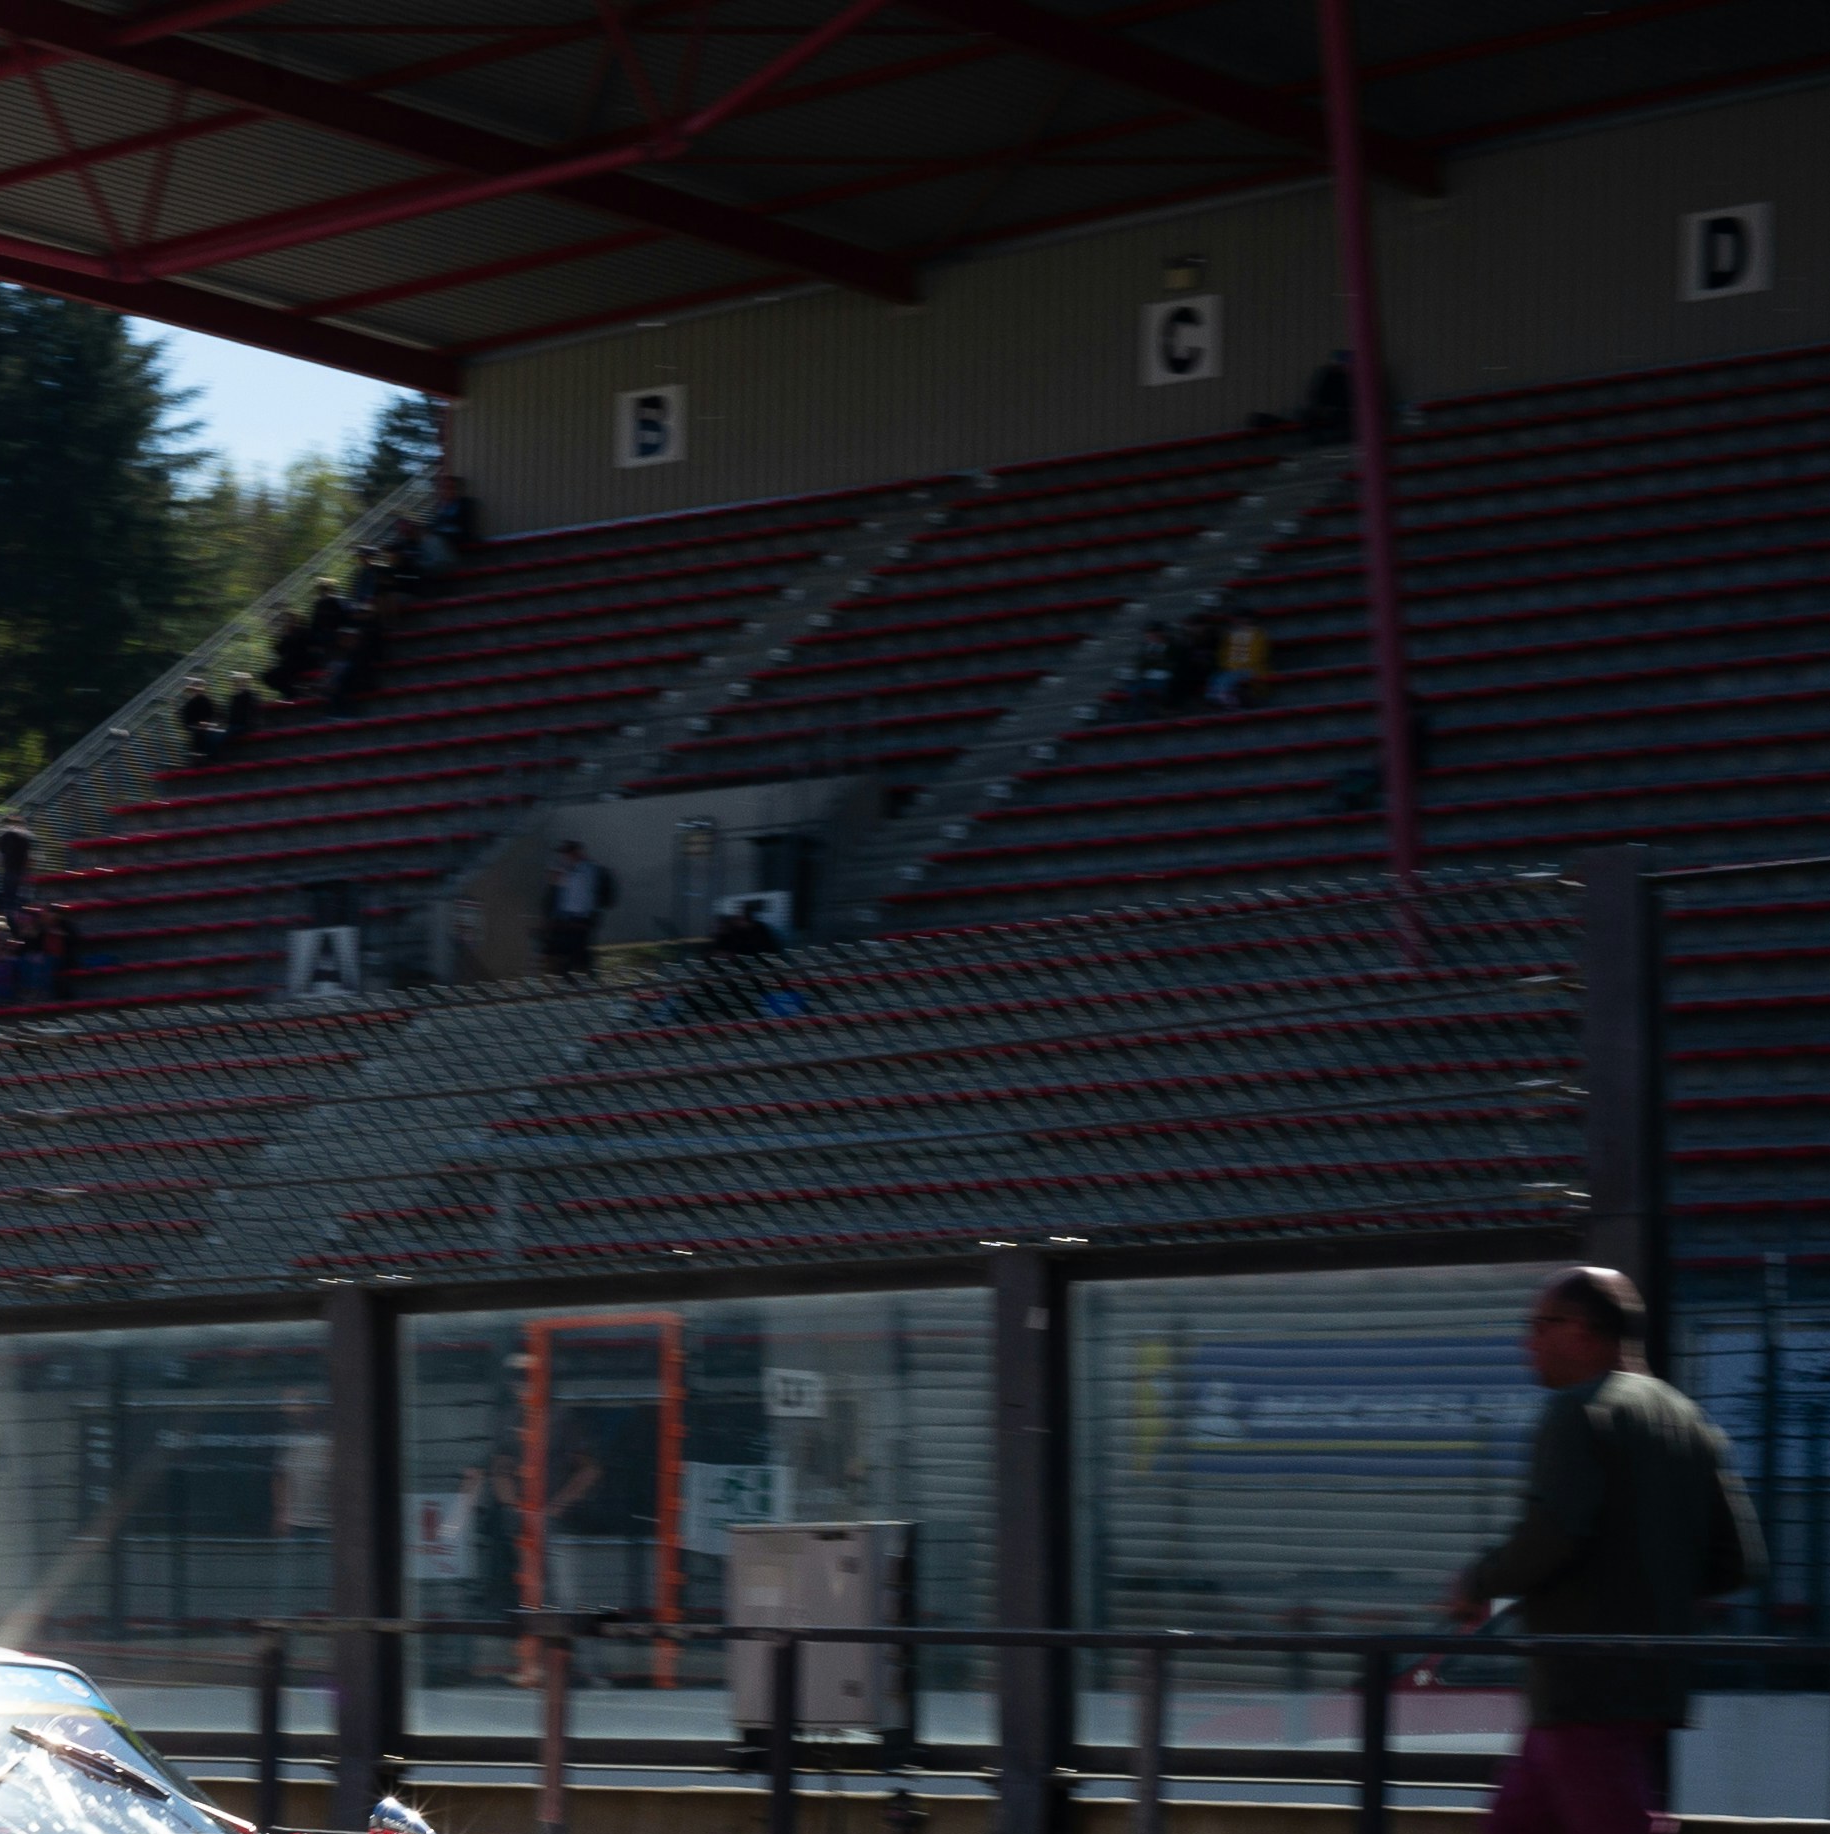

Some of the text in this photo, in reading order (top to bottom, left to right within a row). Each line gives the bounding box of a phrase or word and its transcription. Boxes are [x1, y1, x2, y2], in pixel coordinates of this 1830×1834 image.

[1700, 217, 1749, 290] D
[1161, 306, 1206, 375] C
[634, 395, 669, 459] B
[298, 931, 358, 993] A
